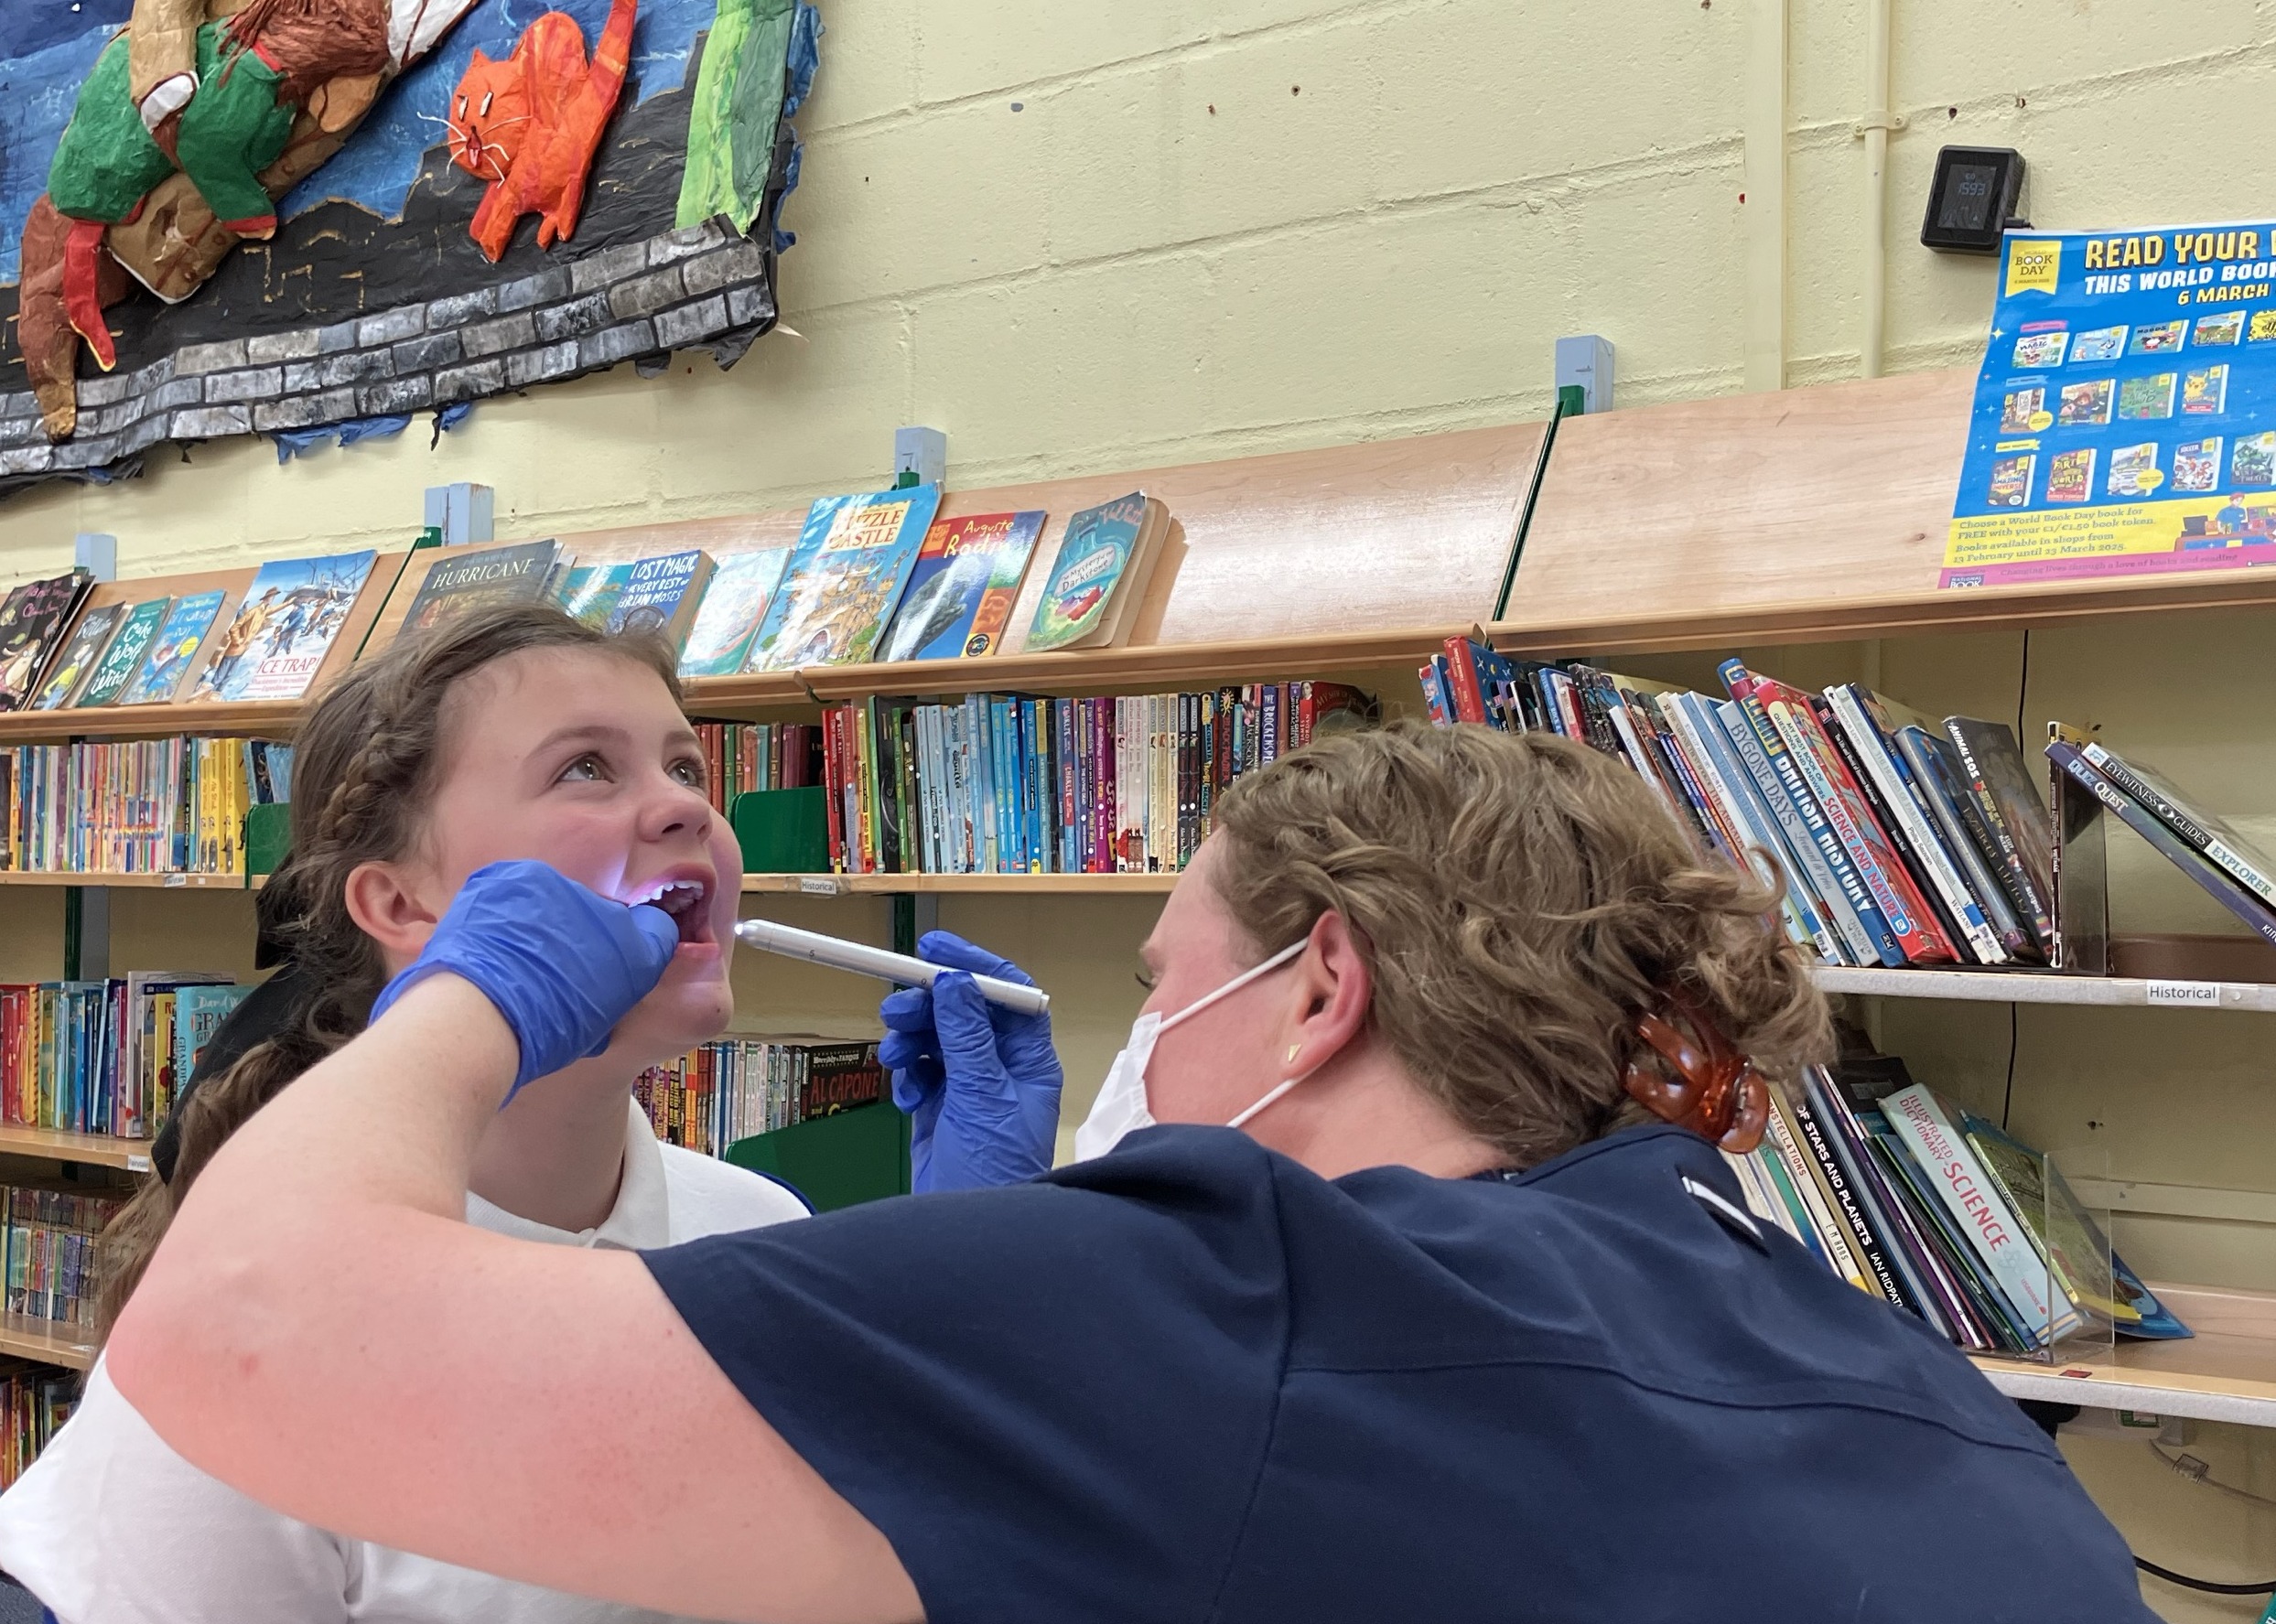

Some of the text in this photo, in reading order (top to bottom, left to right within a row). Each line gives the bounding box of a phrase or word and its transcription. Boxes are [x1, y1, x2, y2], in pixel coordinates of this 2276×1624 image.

[2015, 255, 2054, 266] BOOK
[2085, 230, 2259, 270] READ YOUR
[2020, 265, 2048, 275] DAY
[2085, 274, 2131, 295] THIS
[2139, 266, 2214, 291] WORLD
[2177, 283, 2271, 306] 6 MARCH
[964, 520, 1015, 536] Auguste
[1958, 530, 1988, 540] FREE
[1990, 528, 2013, 538] with
[2015, 526, 2040, 537] your
[2092, 519, 2120, 528] book
[1959, 520, 1998, 529] Choose
[2009, 515, 2040, 525] World
[2044, 514, 2071, 522] Book
[2074, 512, 2096, 521] Day
[2098, 508, 2125, 518] book
[2127, 507, 2143, 515] for
[827, 527, 899, 549] CASTLE
[1956, 543, 1987, 553] Books
[1990, 539, 2037, 550] available
[2053, 534, 2086, 544] shops
[2087, 532, 2114, 541] from
[1967, 551, 2014, 562] February
[2016, 547, 2043, 556] until
[2060, 543, 2095, 554] March
[432, 558, 535, 590] HURRICANE
[630, 554, 700, 582] LOST MAGIC
[1062, 560, 1108, 592] Darkstone
[1070, 557, 1099, 577] Mystery
[619, 588, 685, 608] BRIAN MOSES
[635, 576, 680, 594] VERY BEST
[124, 619, 154, 643] Cake
[108, 638, 148, 670] Wolf
[257, 657, 321, 674] ICE TRAP!
[91, 663, 135, 695] Witch
[1264, 694, 1274, 704] THE
[1246, 723, 1255, 767] JACKSON
[1773, 712, 1827, 801] QUESTIONS AND ANSWERS
[1785, 721, 1825, 784] MY FIRST BOOK OF
[1834, 733, 1843, 743] The
[1842, 747, 1850, 757] and
[1947, 722, 1982, 780] ANIMAL SOS
[1728, 721, 1775, 787] BYGONE
[1764, 783, 1799, 828] DAYS
[2068, 758, 2130, 814] QUIZ QUEST
[1709, 788, 1746, 851] THE ARMADA
[1873, 749, 1889, 768] THE
[1882, 765, 1903, 791] HOUSES
[1904, 801, 1936, 849] PARLIAMENT
[1931, 850, 1947, 869] Nigel
[1941, 866, 1958, 887] Smith
[2106, 761, 2160, 808] EYEWITNESS
[2173, 815, 2209, 846] GUIDES
[2210, 844, 2273, 898] EXPLORER
[1772, 752, 1879, 917] BRITISH HISTORY
[1906, 826, 1922, 844] Philip
[1916, 843, 1934, 866] Sauvain
[1822, 795, 1902, 920] SCIENCE AND NATURE
[802, 881, 835, 891] Historical
[2023, 885, 2044, 914] stripes
[1848, 917, 1874, 956] CHANCELLOR
[2150, 984, 2217, 1001] Historical
[811, 1071, 879, 1105] AL CAPONE
[1794, 1102, 1812, 1122] OF
[1907, 1091, 1955, 1161] ILLUSTRATED
[1769, 1102, 1807, 1178] ONSTELLATIONS
[1801, 1120, 1833, 1162] STARS
[1821, 1158, 1848, 1190] AND
[1898, 1095, 1946, 1164] DICTIONARY
[1941, 1157, 2012, 1255] SCIENCE
[1834, 1188, 1877, 1247] PLANETS
[1868, 1250, 1887, 1273] IAN
[2020, 1276, 2042, 1308] USBORNE
